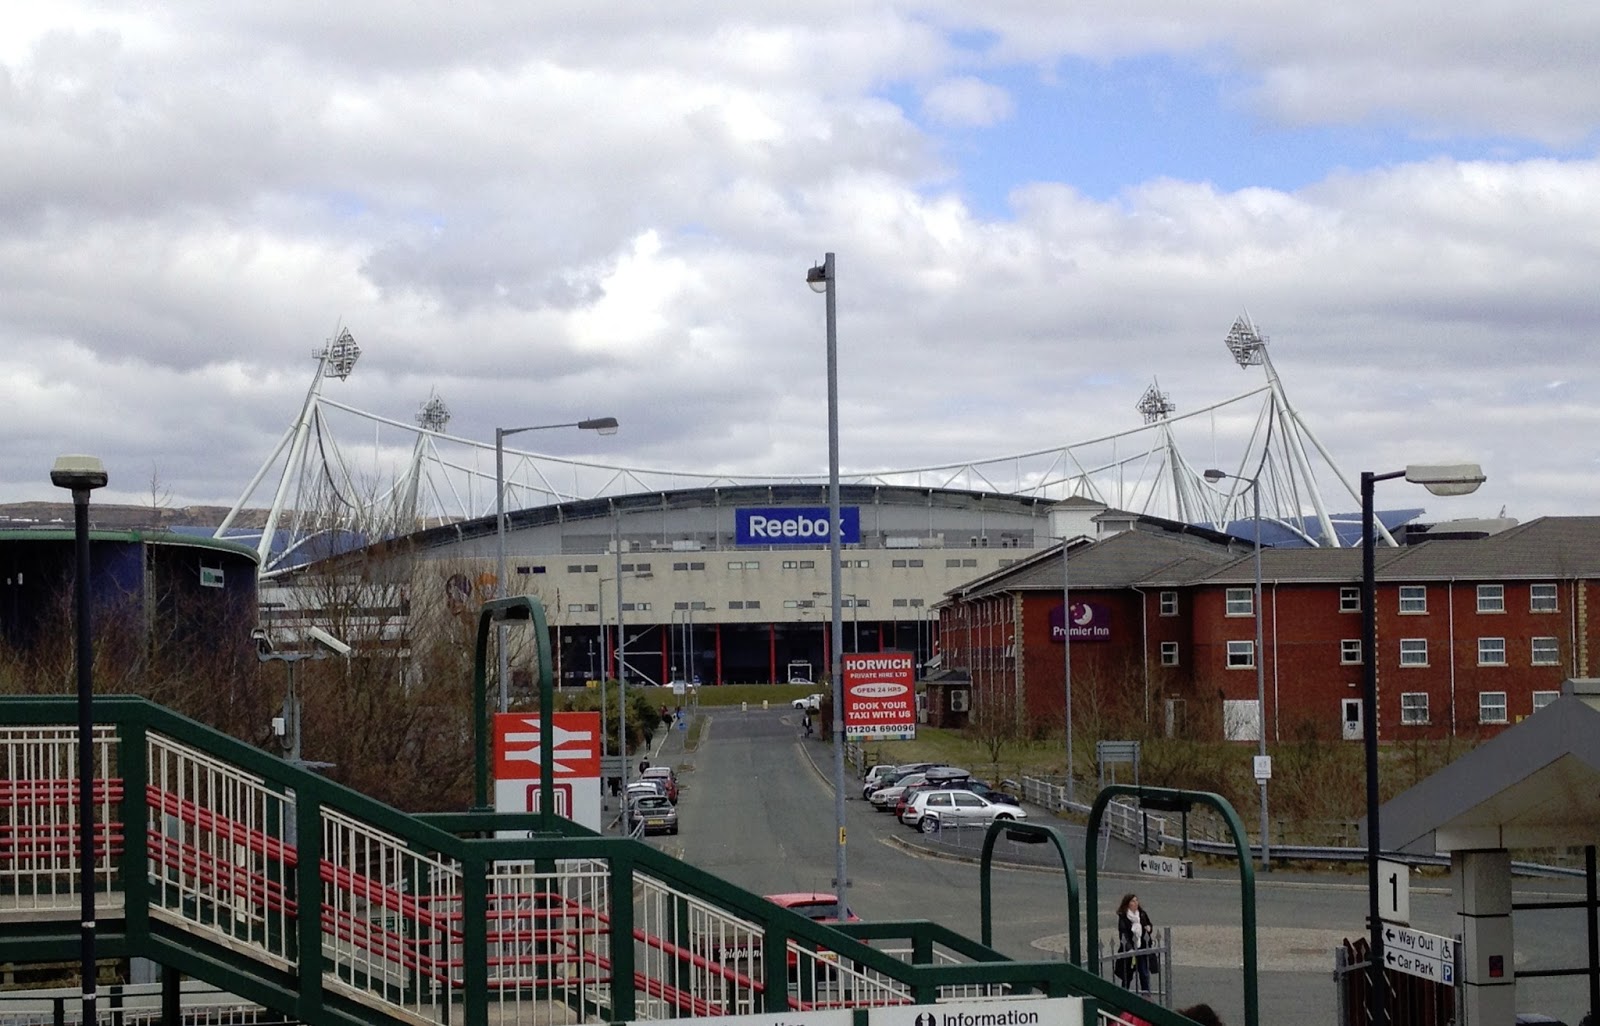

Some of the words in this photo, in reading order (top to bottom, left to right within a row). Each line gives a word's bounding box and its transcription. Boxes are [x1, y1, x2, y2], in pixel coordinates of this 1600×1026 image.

[1093, 626, 1109, 636] Inn
[846, 659, 911, 670] HORWICH
[852, 702, 879, 710] BOOK
[881, 701, 907, 709] YOUR
[872, 711, 896, 719] WITH
[898, 710, 911, 718] US
[880, 724, 914, 732] 690096
[1149, 860, 1160, 874] Way
[1162, 861, 1173, 872] Out
[1389, 873, 1398, 912] 1
[1398, 931, 1416, 949] Way
[1418, 935, 1434, 951] Out
[1397, 954, 1412, 970] Car
[1415, 960, 1434, 976] Park
[943, 1010, 1038, 1026] Information
